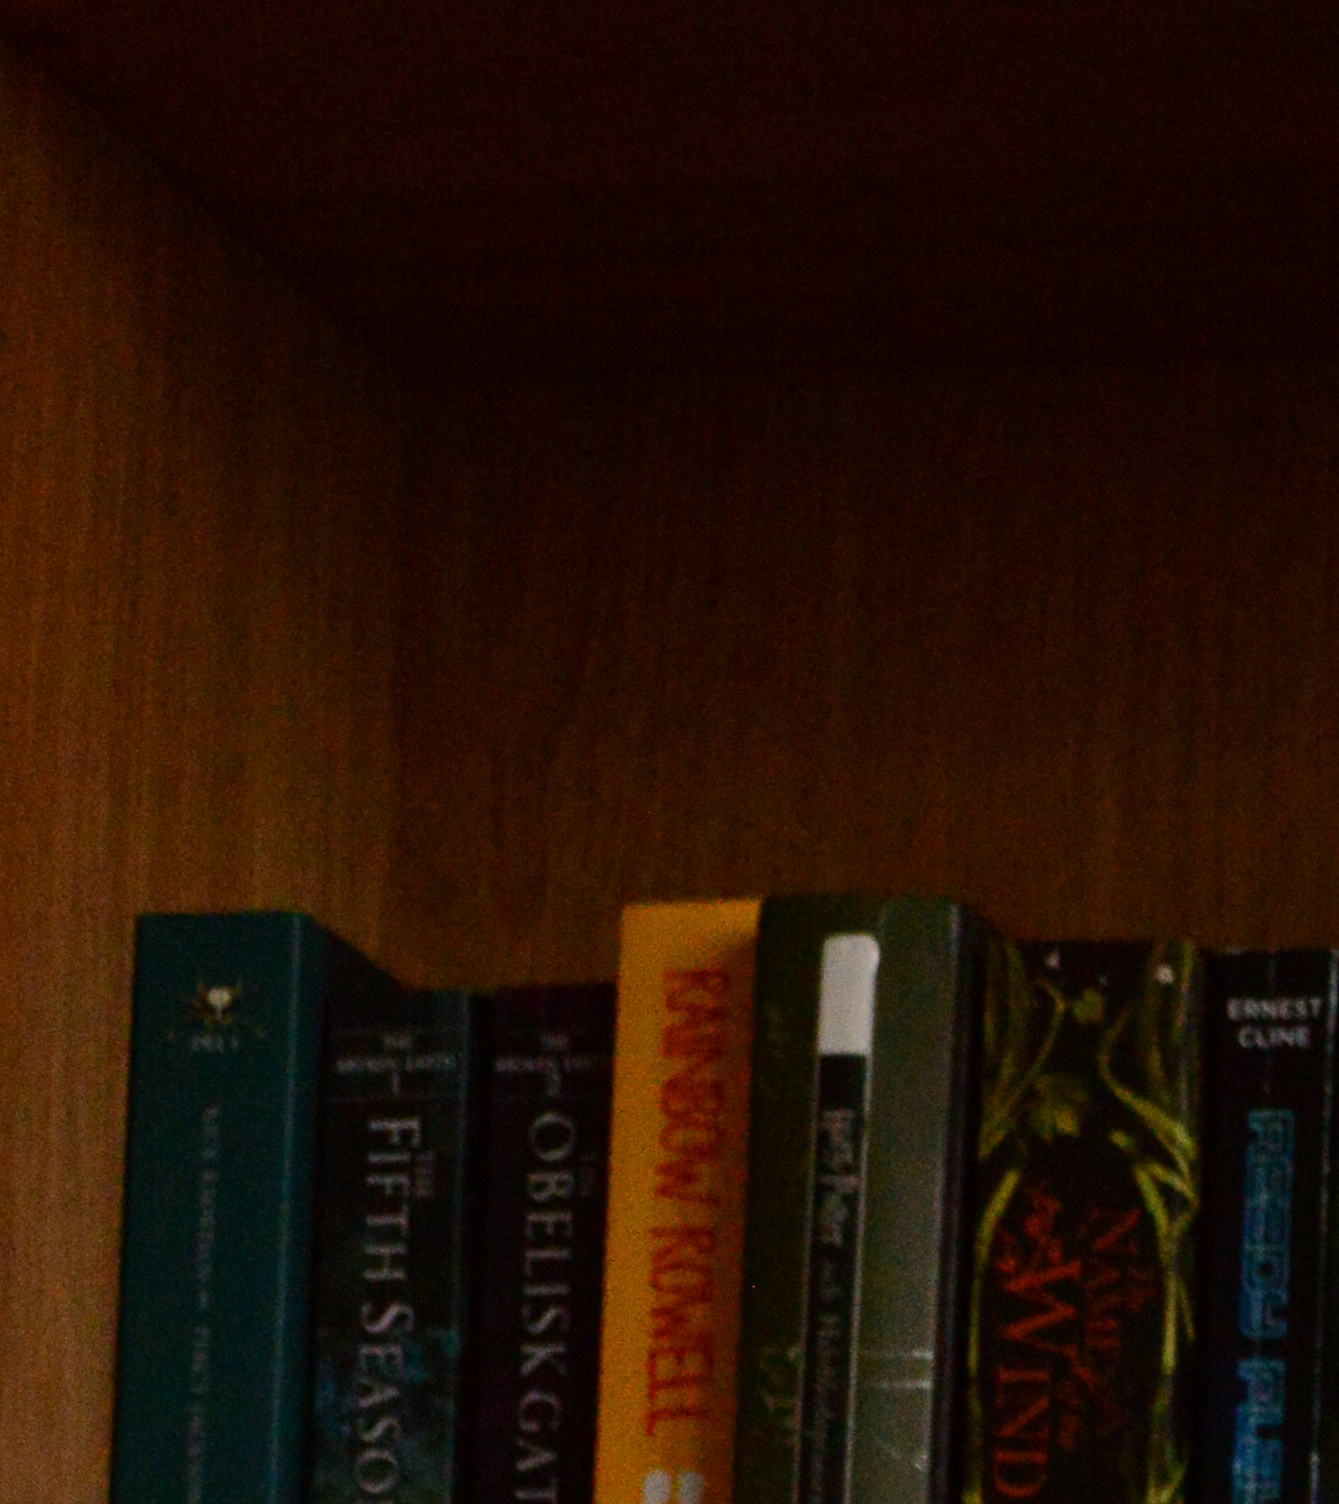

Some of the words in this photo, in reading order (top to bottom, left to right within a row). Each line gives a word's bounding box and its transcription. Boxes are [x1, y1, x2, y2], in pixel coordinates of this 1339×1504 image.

[657, 967, 731, 1203] RAINBOW
[1225, 998, 1323, 1023] ERNEST
[1237, 1026, 1312, 1051] CLINE
[359, 1114, 421, 1281] FIFTH
[516, 1110, 579, 1379] OBELISK
[644, 1225, 716, 1437] ROWELL
[990, 1245, 1082, 1500] WIND
